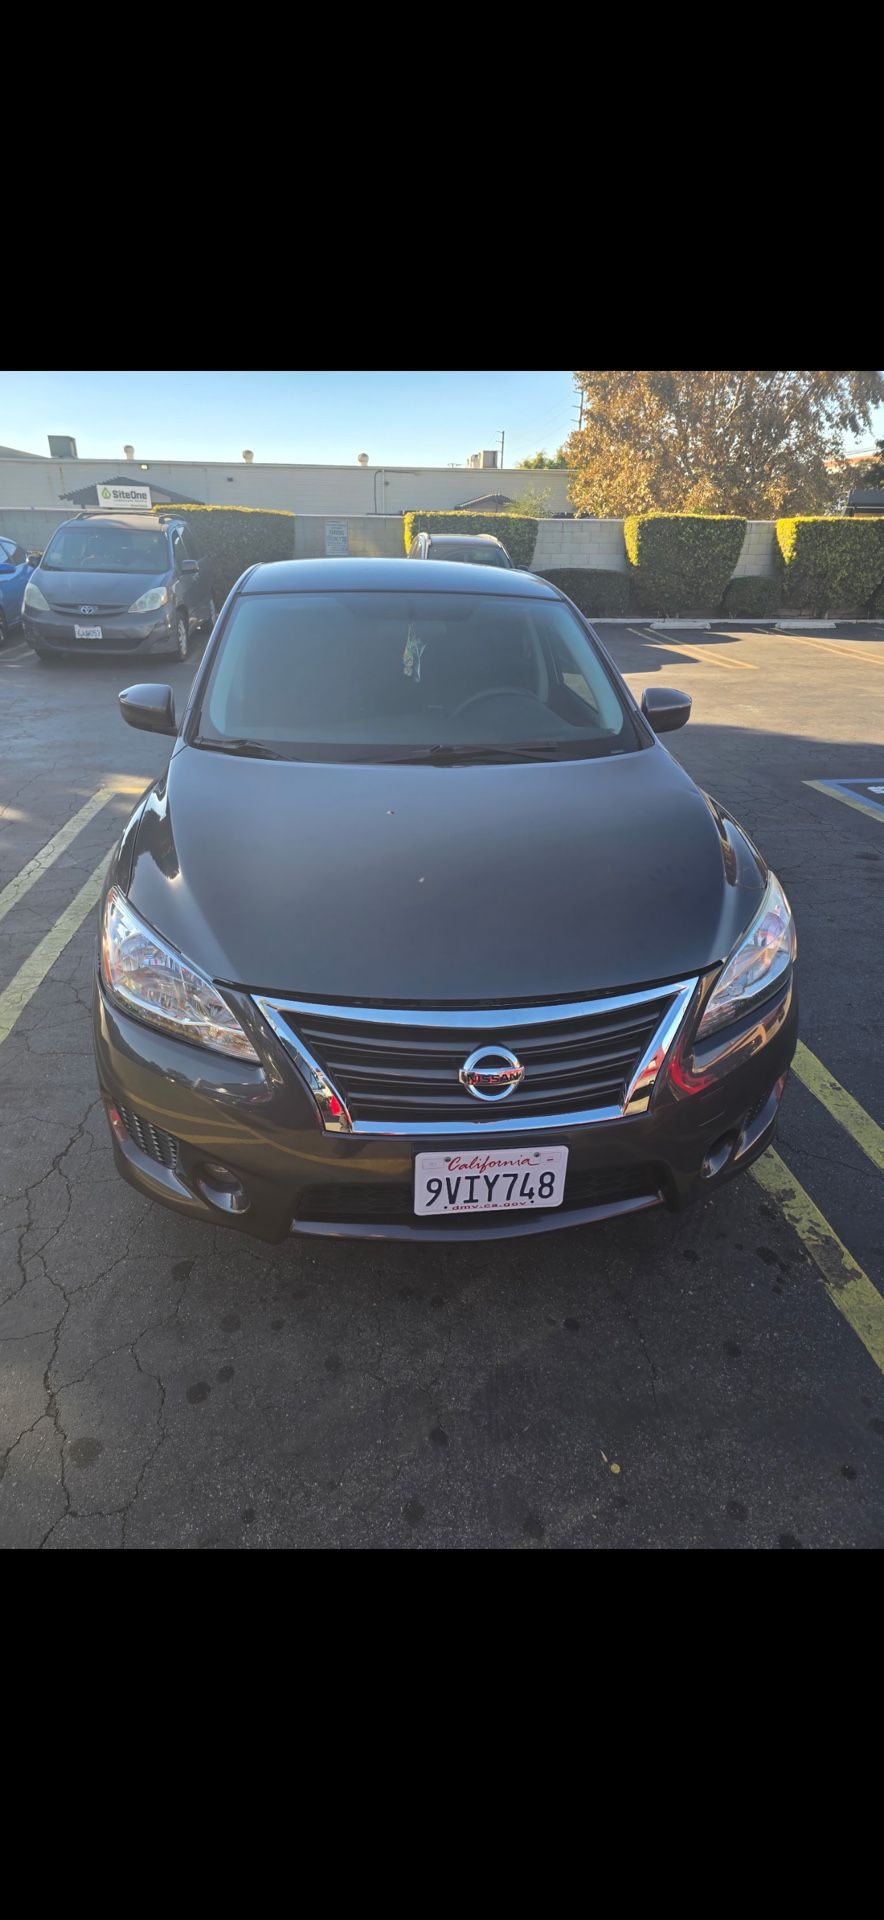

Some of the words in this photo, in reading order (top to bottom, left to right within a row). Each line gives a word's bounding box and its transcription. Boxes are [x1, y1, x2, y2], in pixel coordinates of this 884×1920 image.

[112, 490, 148, 499] SiteOne
[467, 1070, 520, 1086] NISSAN
[448, 1155, 540, 1173] California
[426, 1171, 555, 1207] 9VIY748
[452, 1201, 527, 1211] dmv.ca.gov
